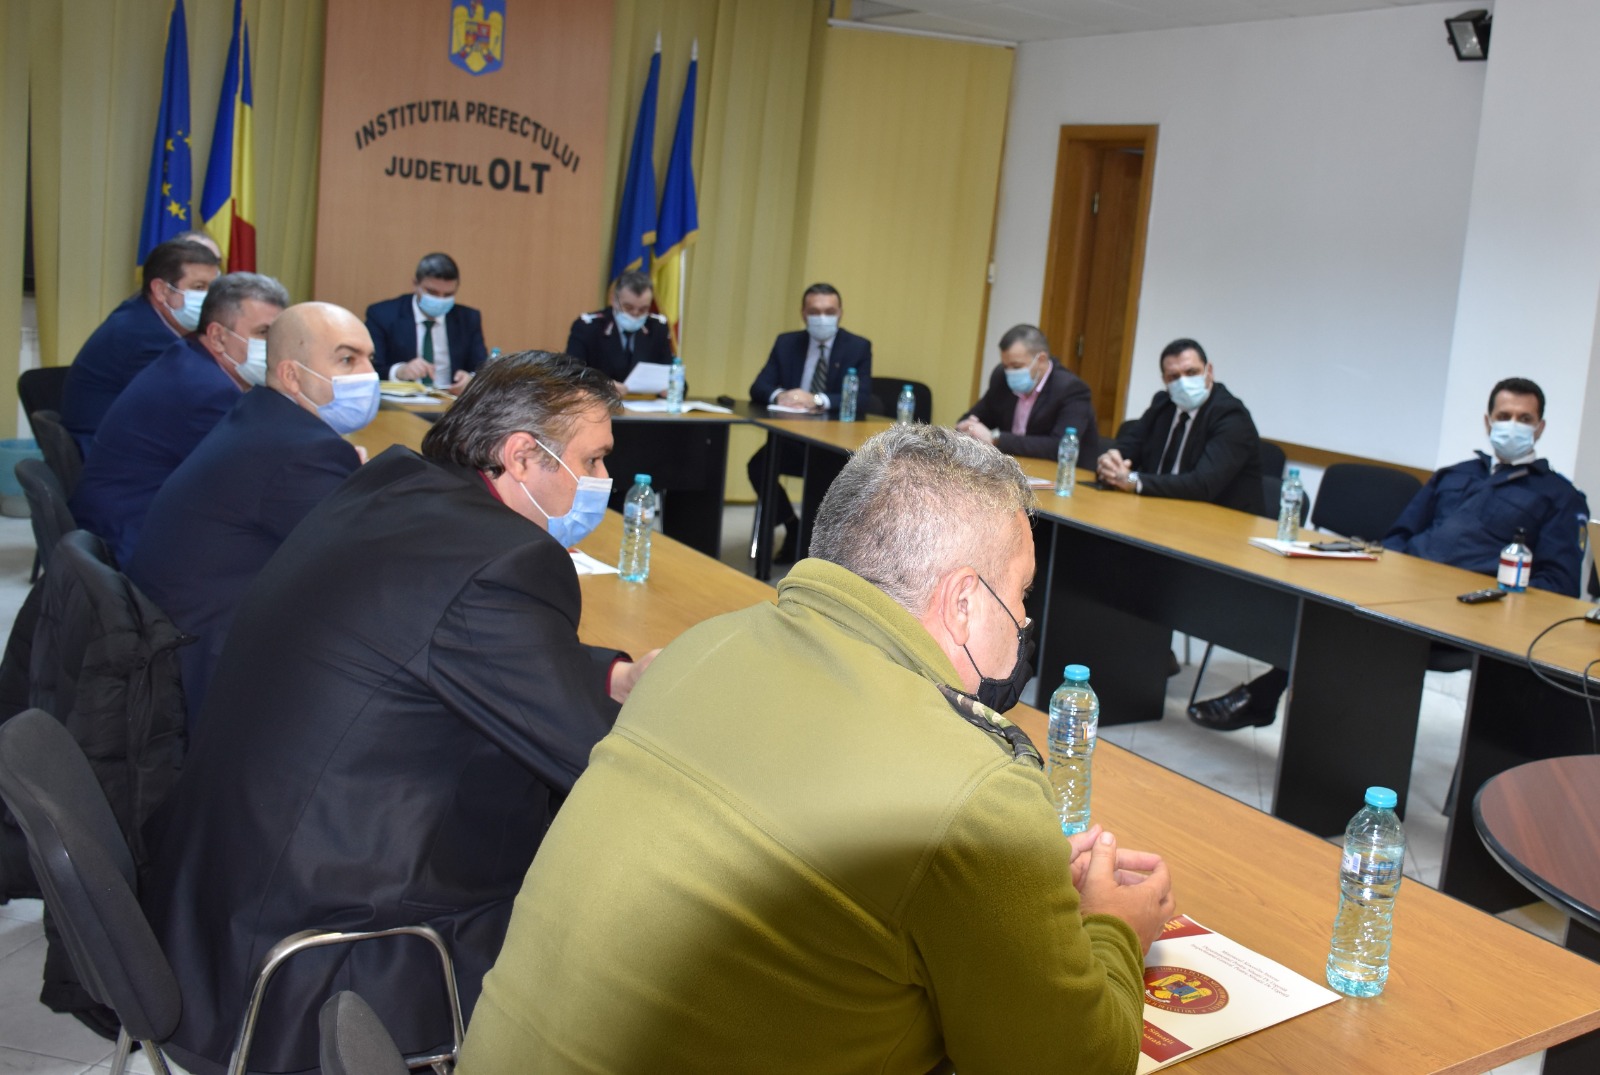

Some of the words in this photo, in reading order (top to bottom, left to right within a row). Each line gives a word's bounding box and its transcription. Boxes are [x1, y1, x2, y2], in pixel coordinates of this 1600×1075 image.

[355, 100, 460, 150] INSTITUTIA
[465, 101, 581, 174] PREFECTULUI
[384, 155, 484, 187] JUDETUL
[488, 157, 551, 195] OLT
